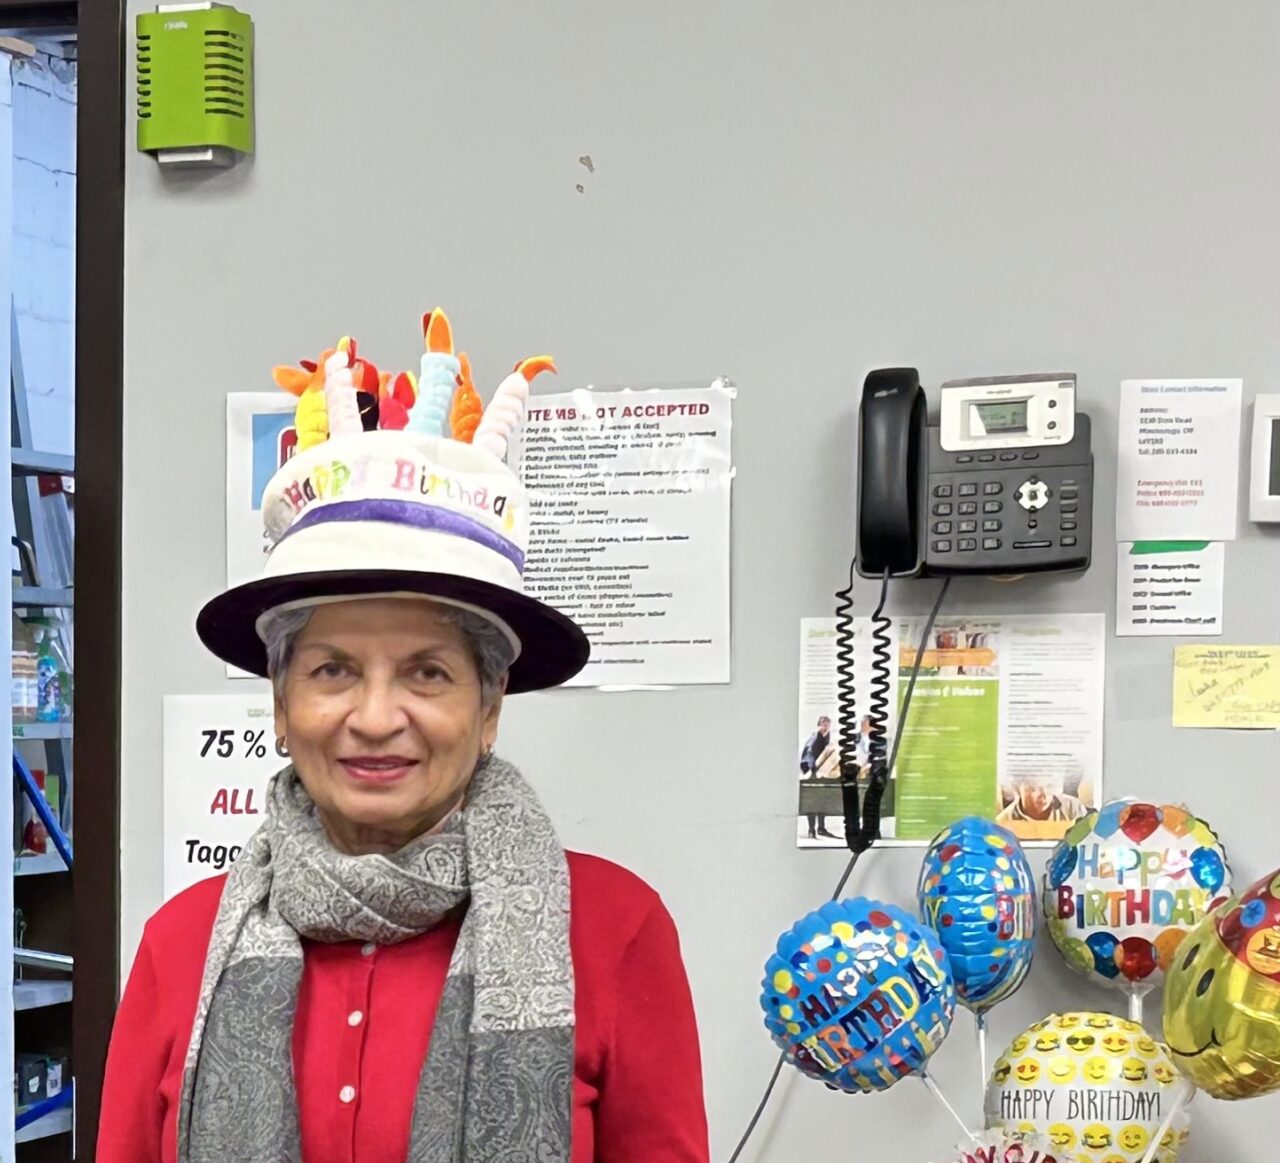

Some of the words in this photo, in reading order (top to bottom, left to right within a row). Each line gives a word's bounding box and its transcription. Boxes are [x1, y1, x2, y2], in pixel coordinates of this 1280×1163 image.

[621, 403, 710, 420] ACCEPTED
[282, 455, 372, 513] Happy
[200, 730, 235, 758] 75
[243, 730, 266, 758] %
[210, 788, 259, 815] ALL
[1057, 885, 1212, 930] BIRTHDAY
[1001, 1089, 1055, 1121] HAPPY
[1066, 1091, 1161, 1121] BIRTHDAY!
